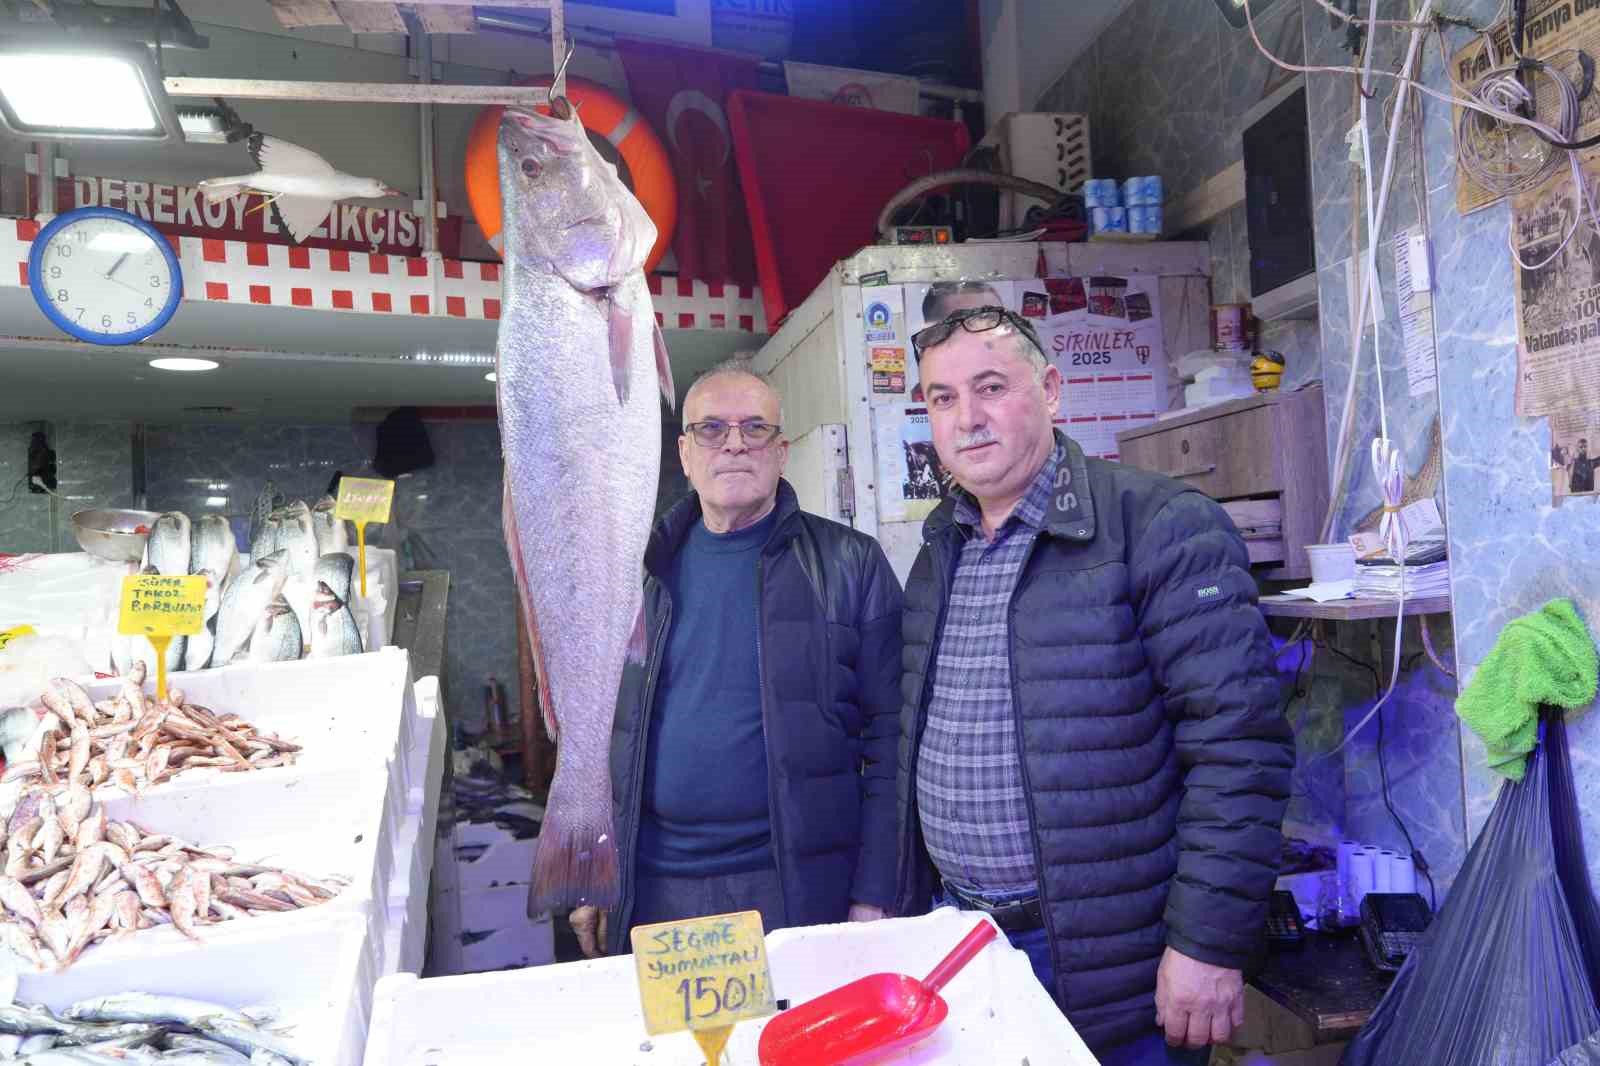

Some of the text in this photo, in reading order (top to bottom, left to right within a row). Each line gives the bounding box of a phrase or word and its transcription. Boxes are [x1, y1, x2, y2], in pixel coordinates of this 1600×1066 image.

[55, 245, 72, 257] 10
[50, 265, 62, 279] 9
[150, 275, 160, 288] 3
[57, 289, 69, 302] 8
[144, 297, 153, 309] 4
[76, 307, 86, 321] 7
[127, 311, 137, 324] 5
[101, 314, 112, 328] 6
[1072, 352, 1111, 366] 2025
